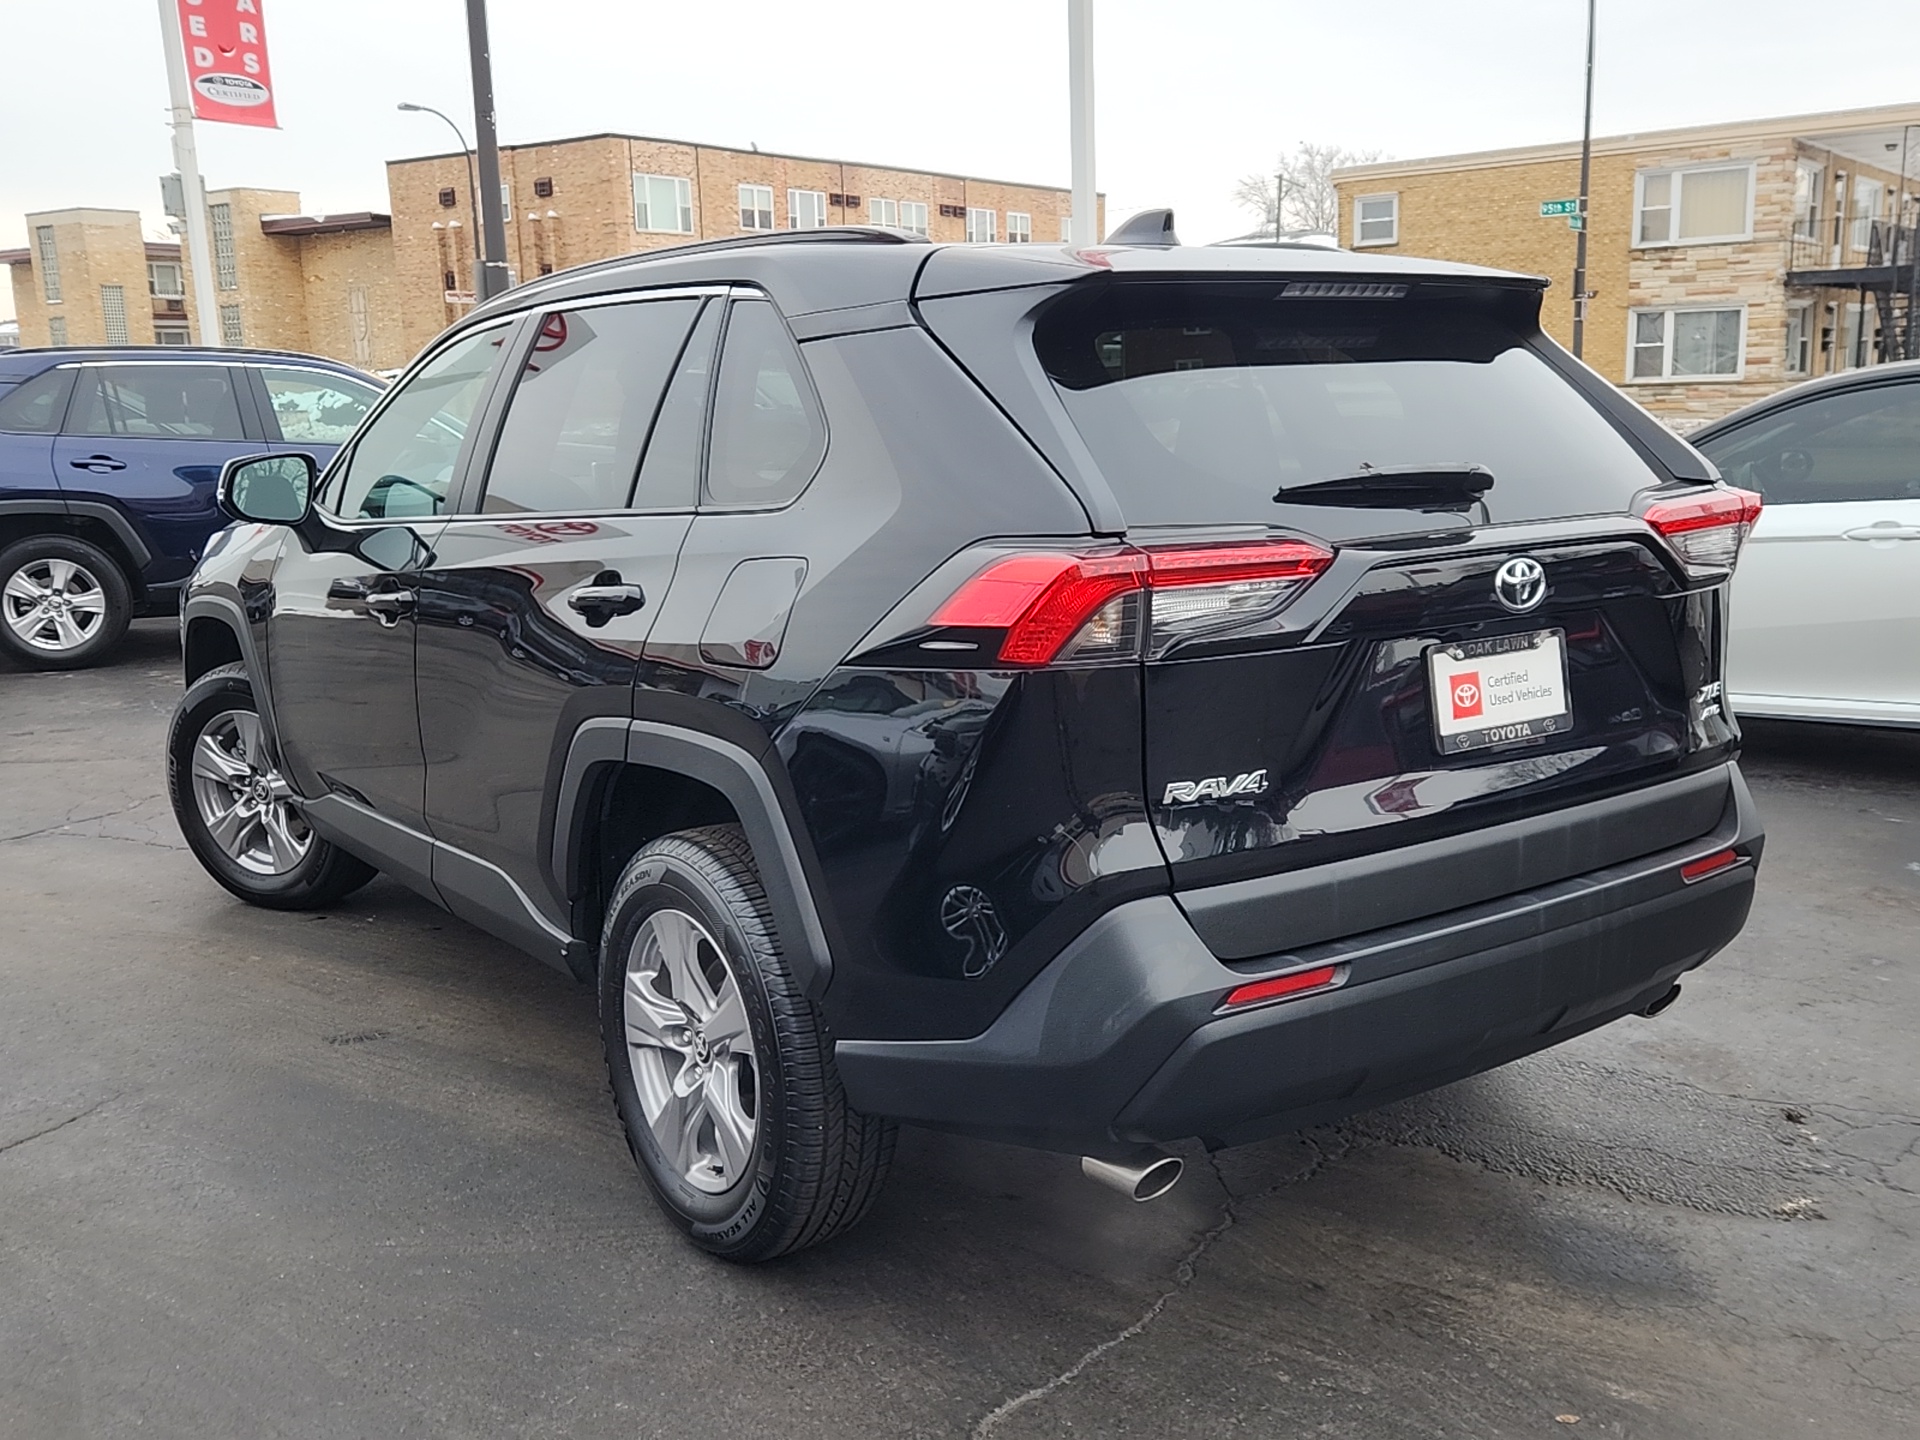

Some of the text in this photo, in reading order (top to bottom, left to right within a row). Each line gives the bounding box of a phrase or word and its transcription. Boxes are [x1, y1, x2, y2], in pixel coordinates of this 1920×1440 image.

[224, 78, 254, 88] TOYOTA
[1467, 635, 1529, 655] OAK LAWN
[1487, 669, 1529, 688] Certified
[1489, 685, 1553, 706] Used Vehicles
[1482, 723, 1532, 743] TOYOTA
[1162, 769, 1269, 804] RAV4
[740, 1198, 757, 1224] ALL
